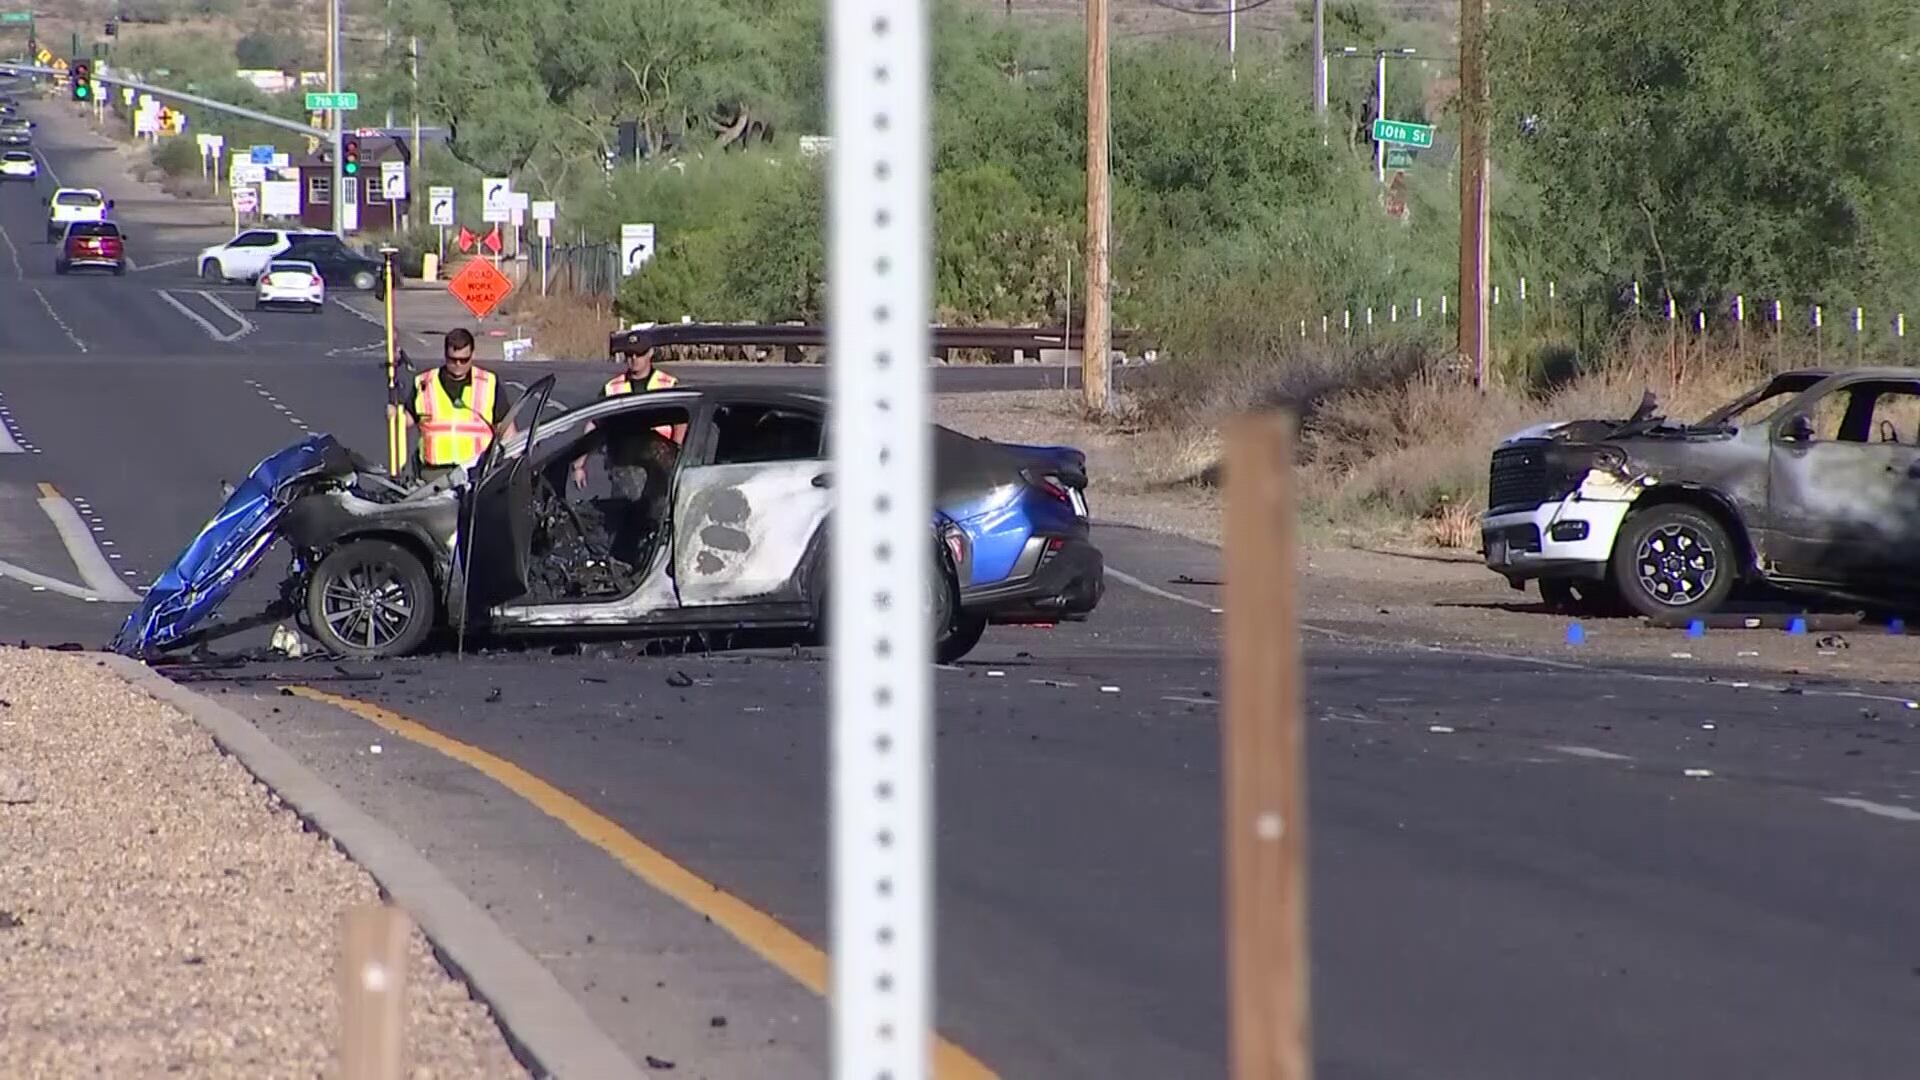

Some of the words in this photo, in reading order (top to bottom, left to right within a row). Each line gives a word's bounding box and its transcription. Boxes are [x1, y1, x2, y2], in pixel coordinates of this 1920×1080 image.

[314, 95, 332, 107] 7th
[337, 95, 350, 107] St
[1379, 123, 1406, 139] 10th
[1411, 130, 1426, 143] St
[467, 270, 493, 279] ROAD
[467, 282, 492, 291] WORK
[465, 293, 496, 302] AHEAD
